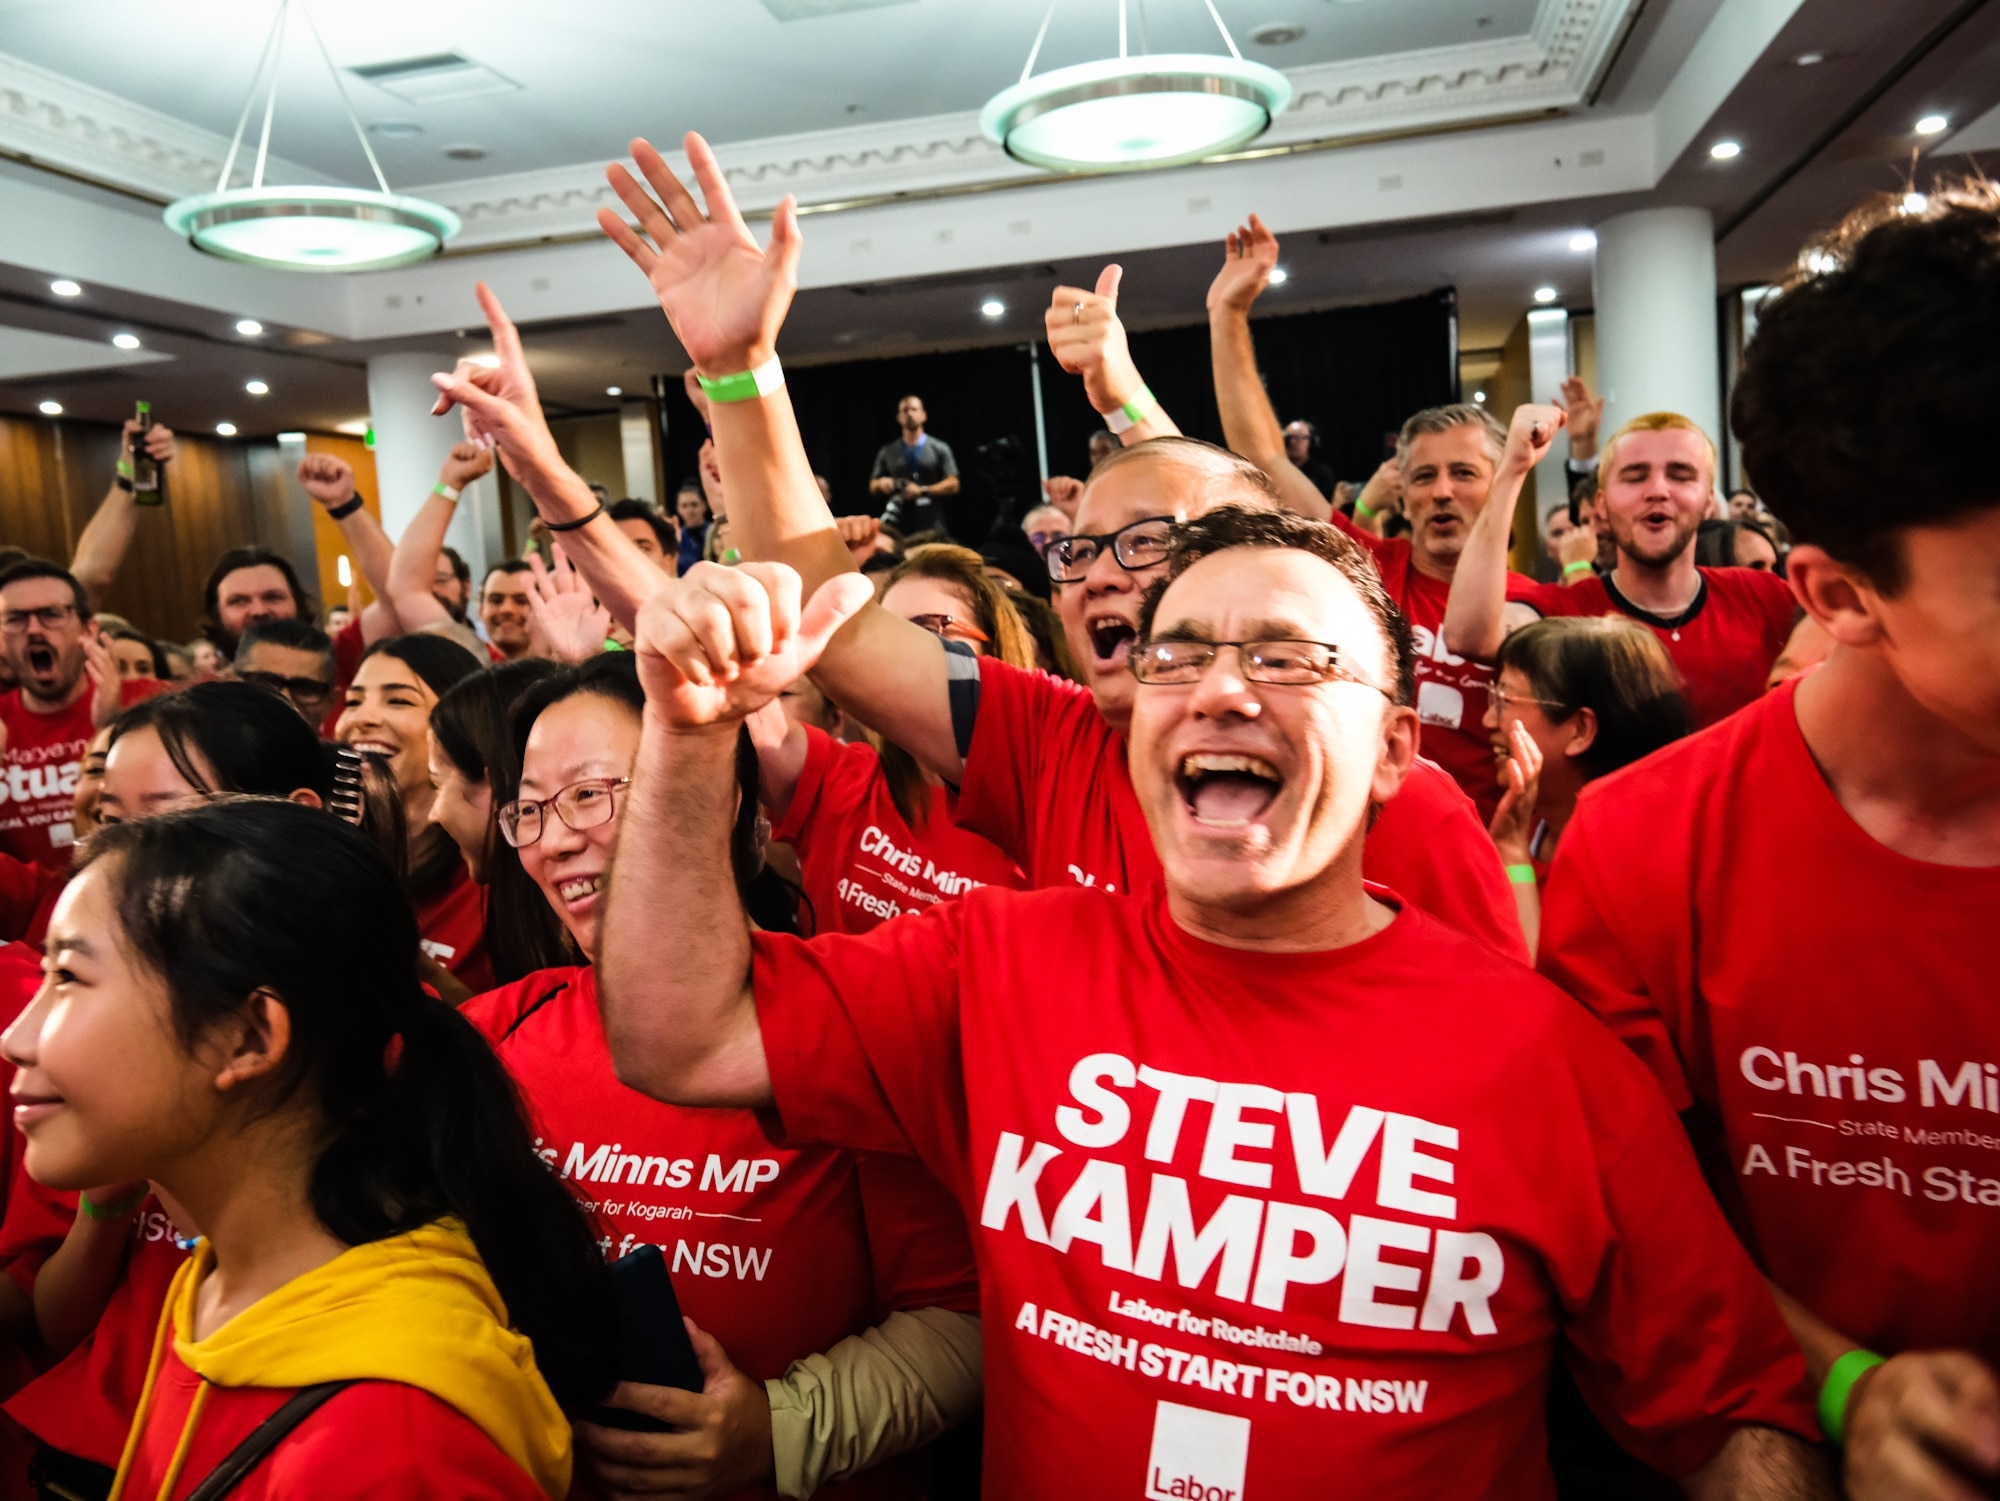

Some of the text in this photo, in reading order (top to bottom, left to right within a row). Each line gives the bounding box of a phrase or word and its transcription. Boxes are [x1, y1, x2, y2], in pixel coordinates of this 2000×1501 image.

[860, 826, 922, 877] Chris
[846, 883, 901, 920] Fresh
[881, 872, 909, 894] State
[1739, 1046, 2000, 1113] Chris Mi
[1055, 1052, 1459, 1220] STEVE
[1838, 1119, 1899, 1139] State
[561, 1142, 694, 1188] Minns
[699, 1153, 780, 1193] MP
[1742, 1144, 1779, 1176] A
[1785, 1146, 1912, 1196] Fresh
[602, 1199, 624, 1215] for
[627, 1201, 693, 1221] Kogarah
[980, 1130, 1504, 1336] KAMPER
[671, 1239, 772, 1281] NSW
[1108, 1291, 1323, 1356] Labor for Rockdale
[1015, 1301, 1428, 1413] A FRESH START FOR NSW
[1153, 1466, 1236, 1501] Labor
